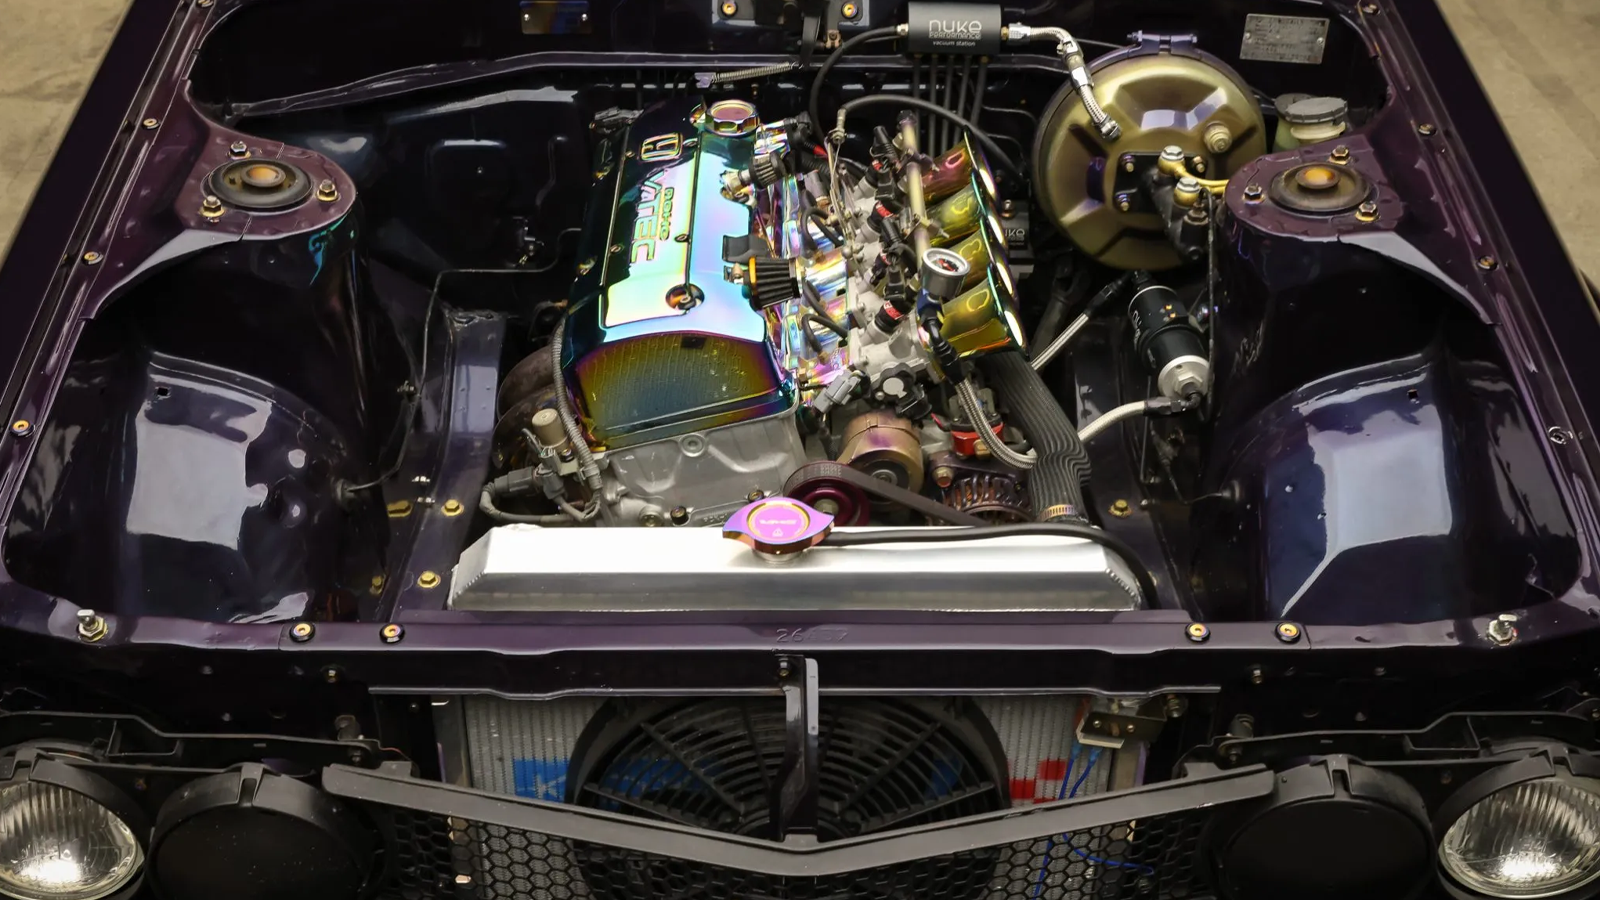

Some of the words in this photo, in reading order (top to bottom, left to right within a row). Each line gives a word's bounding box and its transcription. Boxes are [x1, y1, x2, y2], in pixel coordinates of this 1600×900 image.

[929, 20, 982, 33] nuke
[630, 169, 664, 263] VTEC
[660, 187, 675, 241] DOHC
